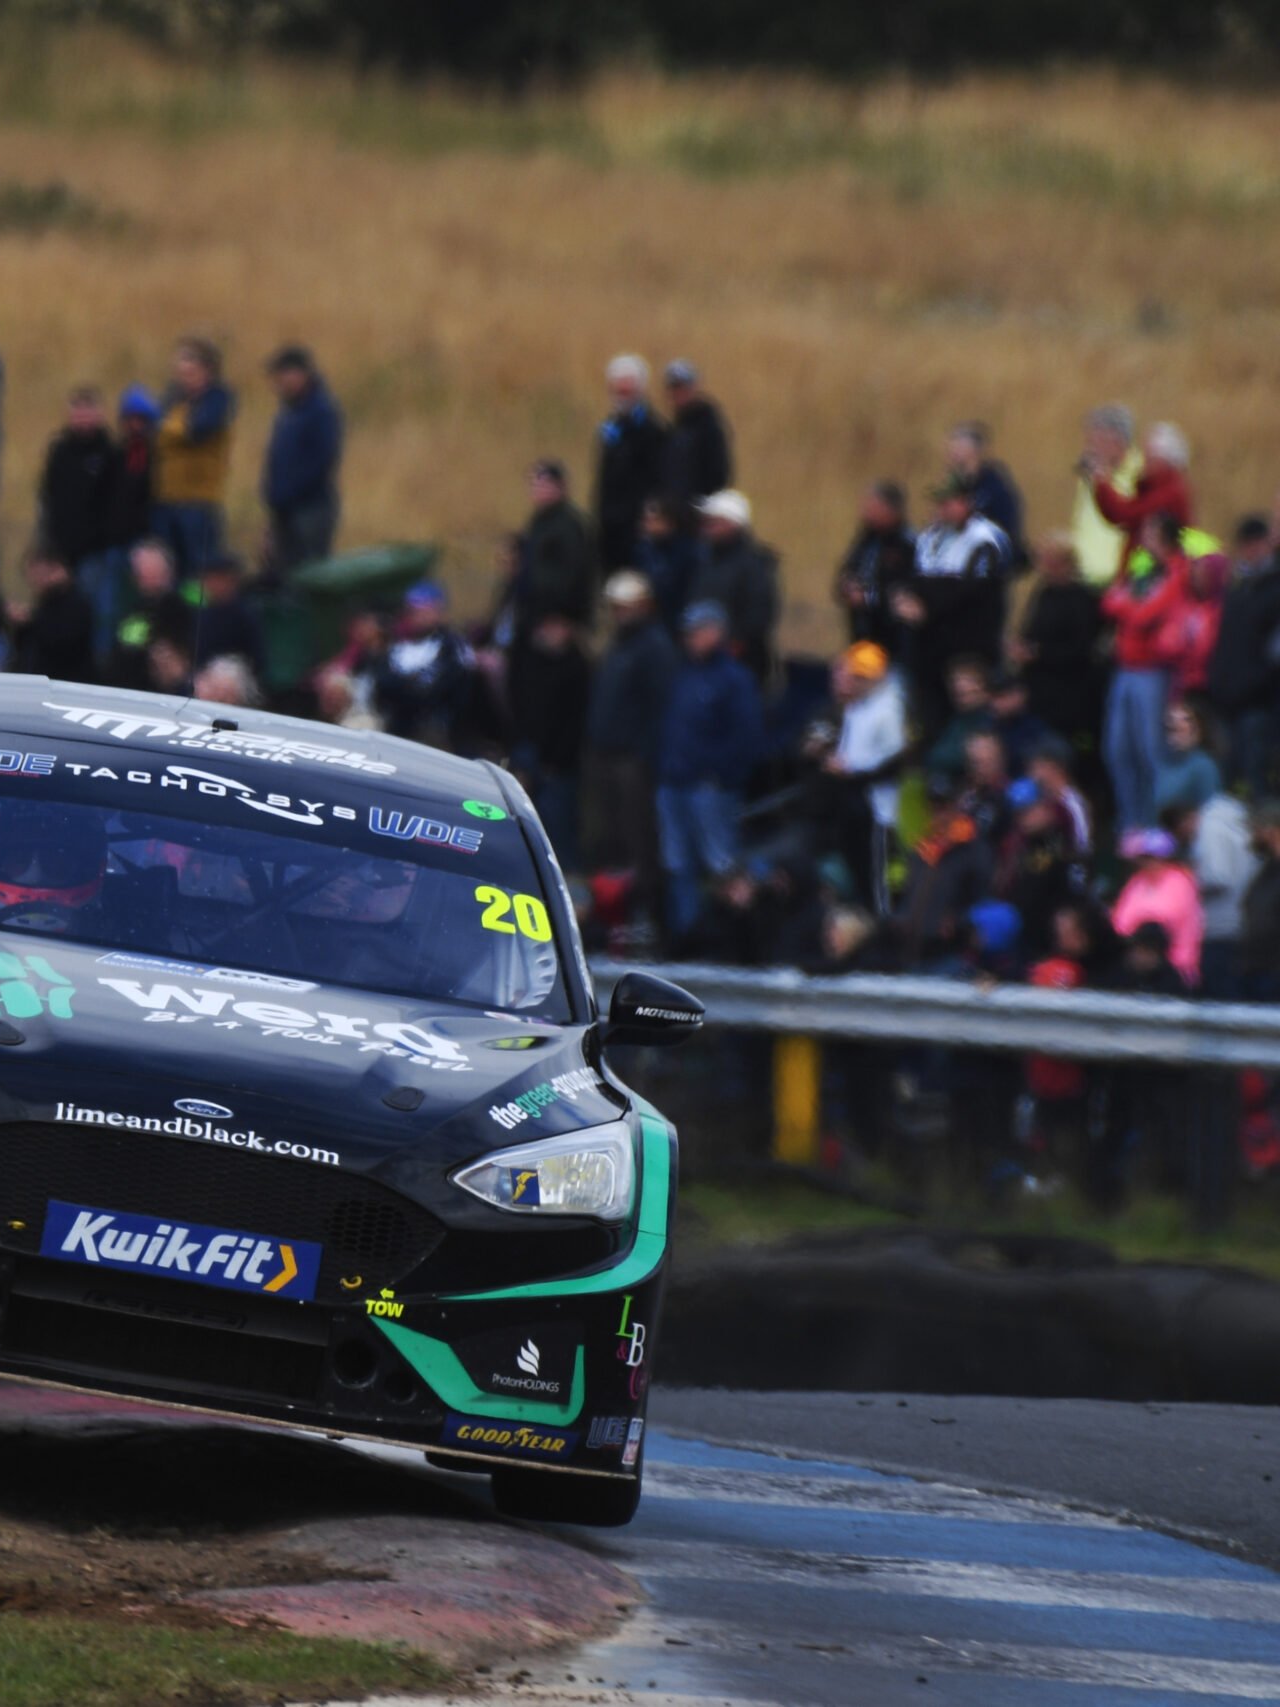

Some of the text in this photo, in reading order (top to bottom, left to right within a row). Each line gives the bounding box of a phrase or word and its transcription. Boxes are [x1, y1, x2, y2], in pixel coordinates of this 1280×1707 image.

[369, 806, 484, 852] WDE
[475, 886, 552, 942] 20
[53, 1101, 341, 1166] limeandblack.com
[365, 1299, 404, 1318] TOW
[456, 1424, 566, 1452] GOODYEAR
